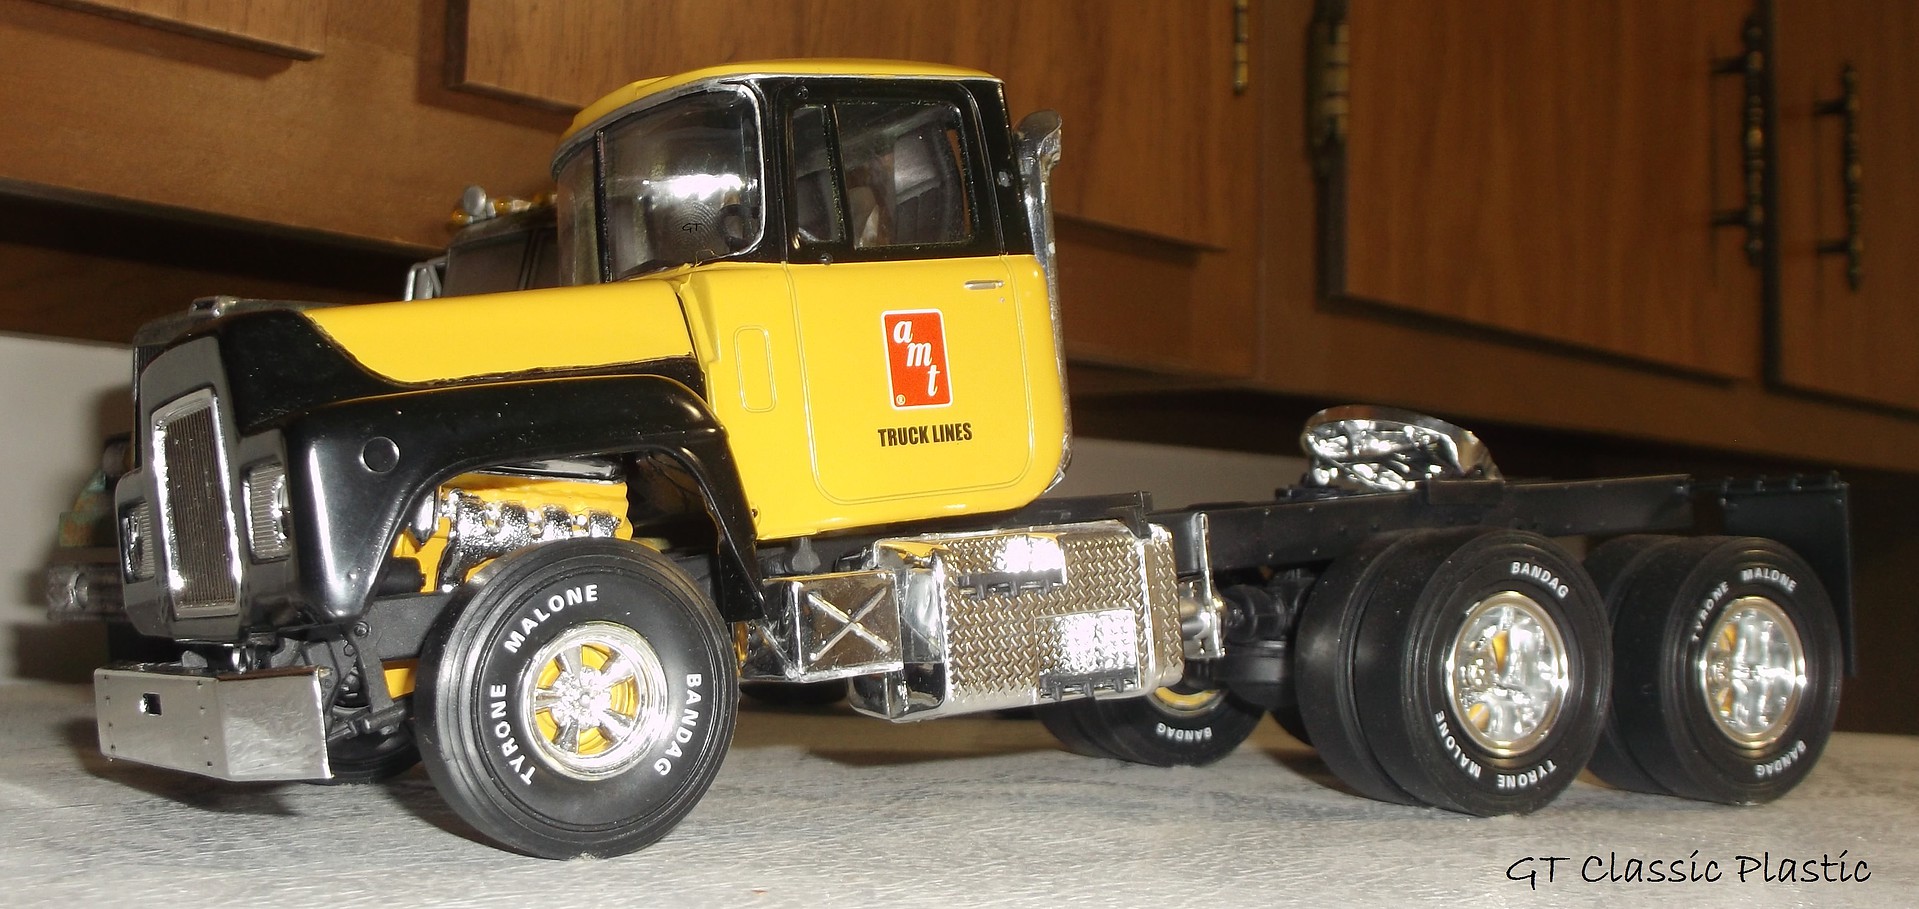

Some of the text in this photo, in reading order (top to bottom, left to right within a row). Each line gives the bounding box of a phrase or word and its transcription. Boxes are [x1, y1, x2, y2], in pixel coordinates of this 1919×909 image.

[892, 320, 941, 397] amt
[877, 422, 973, 447] TRUCK LINES
[1510, 561, 1569, 598] BANDAG
[1691, 567, 1798, 642] TYRONE MALONE
[490, 583, 599, 786] TYRONE MALONE
[653, 673, 702, 776] BANDAG
[1156, 722, 1213, 742] BANDAG
[1434, 710, 1557, 789] TYRONE MALONE
[1754, 740, 1807, 777] BANDAG
